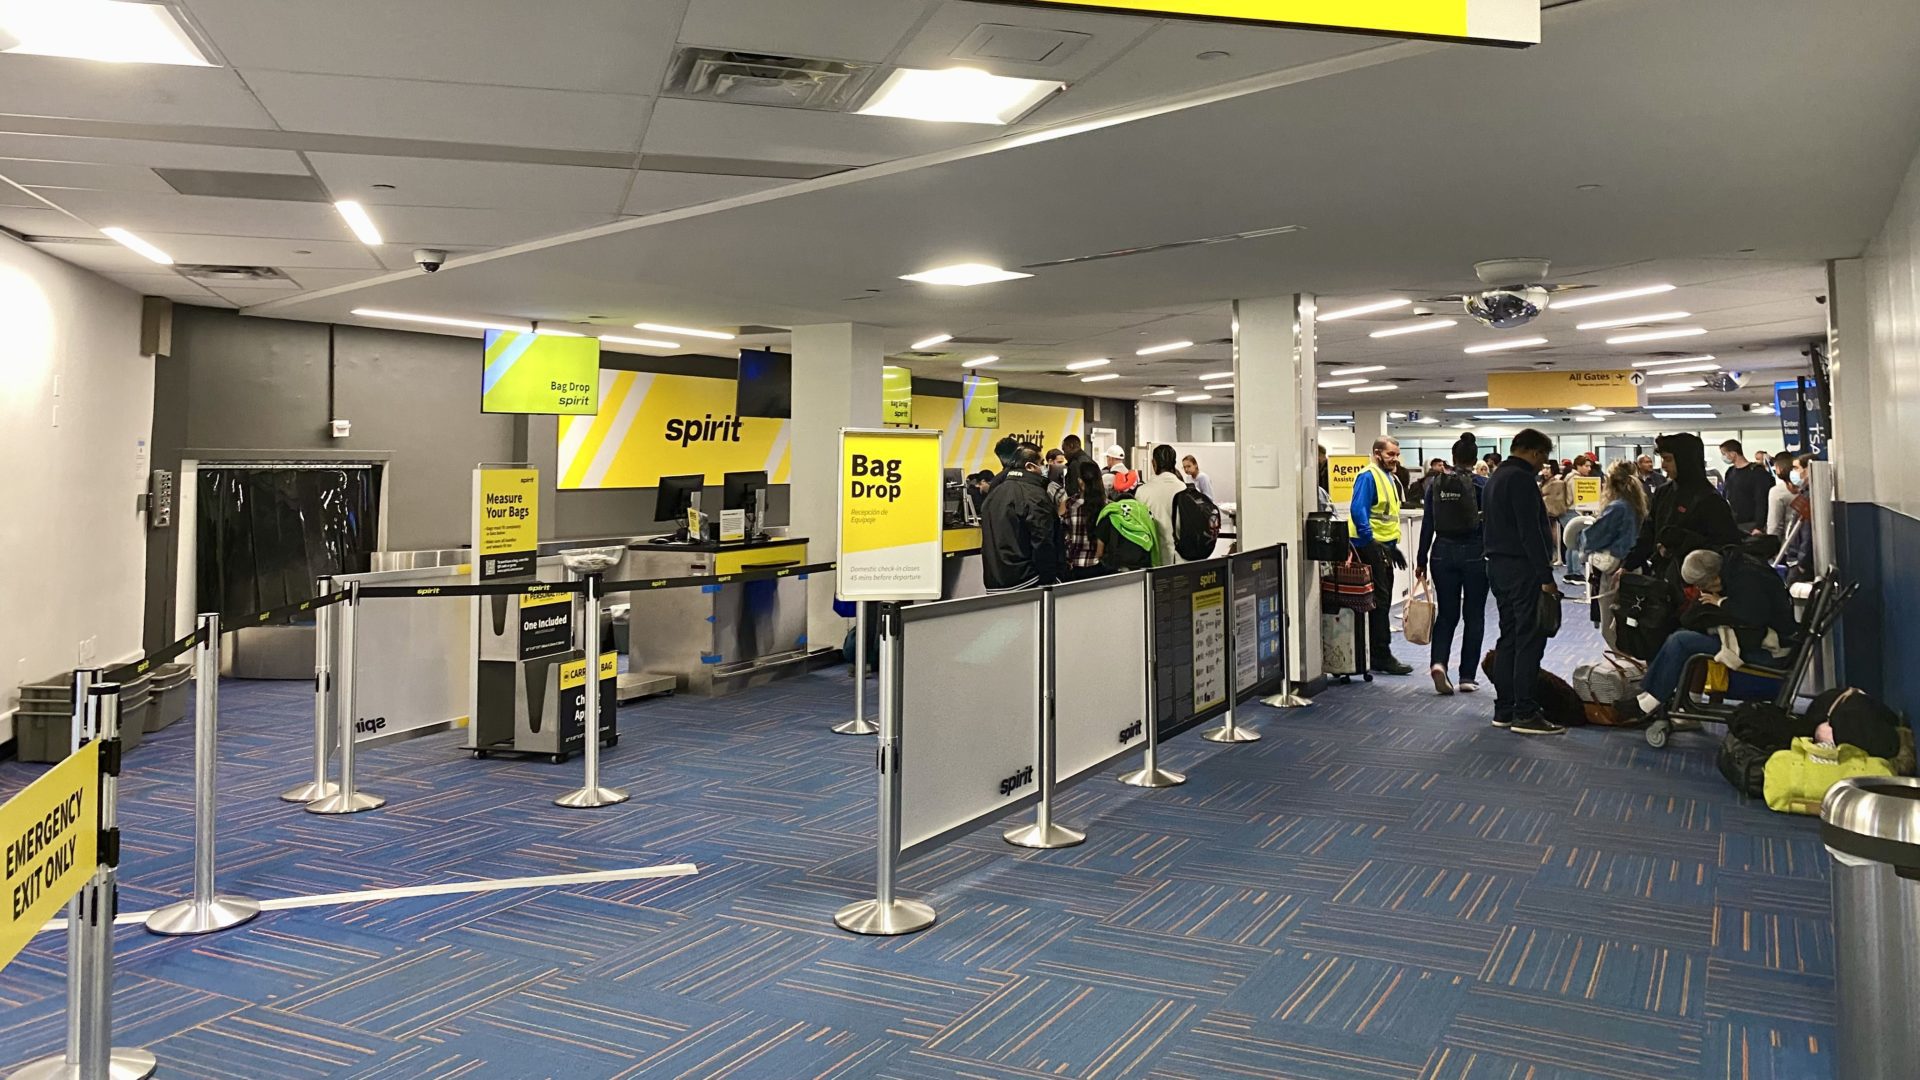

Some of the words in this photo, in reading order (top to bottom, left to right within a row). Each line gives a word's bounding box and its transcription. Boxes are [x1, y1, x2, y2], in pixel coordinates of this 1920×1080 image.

[1569, 373, 1581, 381] All
[1584, 373, 1610, 381] Gates
[551, 381, 567, 393] Bag
[569, 382, 590, 393] Drop
[559, 396, 589, 407] spirit
[665, 413, 742, 448] spirit
[851, 454, 902, 484] Bag
[486, 493, 523, 504] Measure
[851, 480, 902, 503] Drop
[486, 506, 508, 519] Your
[508, 505, 529, 519] Bags
[527, 584, 551, 592] spirit
[1199, 571, 1217, 588] spirit
[417, 586, 441, 595] spirit
[523, 621, 538, 631] One
[538, 614, 568, 629] Included
[600, 661, 613, 672] BAG
[1118, 719, 1142, 745] spirit
[1000, 765, 1034, 797] spirit
[5, 786, 84, 881] EMERGENCY
[12, 864, 44, 922] EXIT
[44, 833, 77, 890] ONLY
